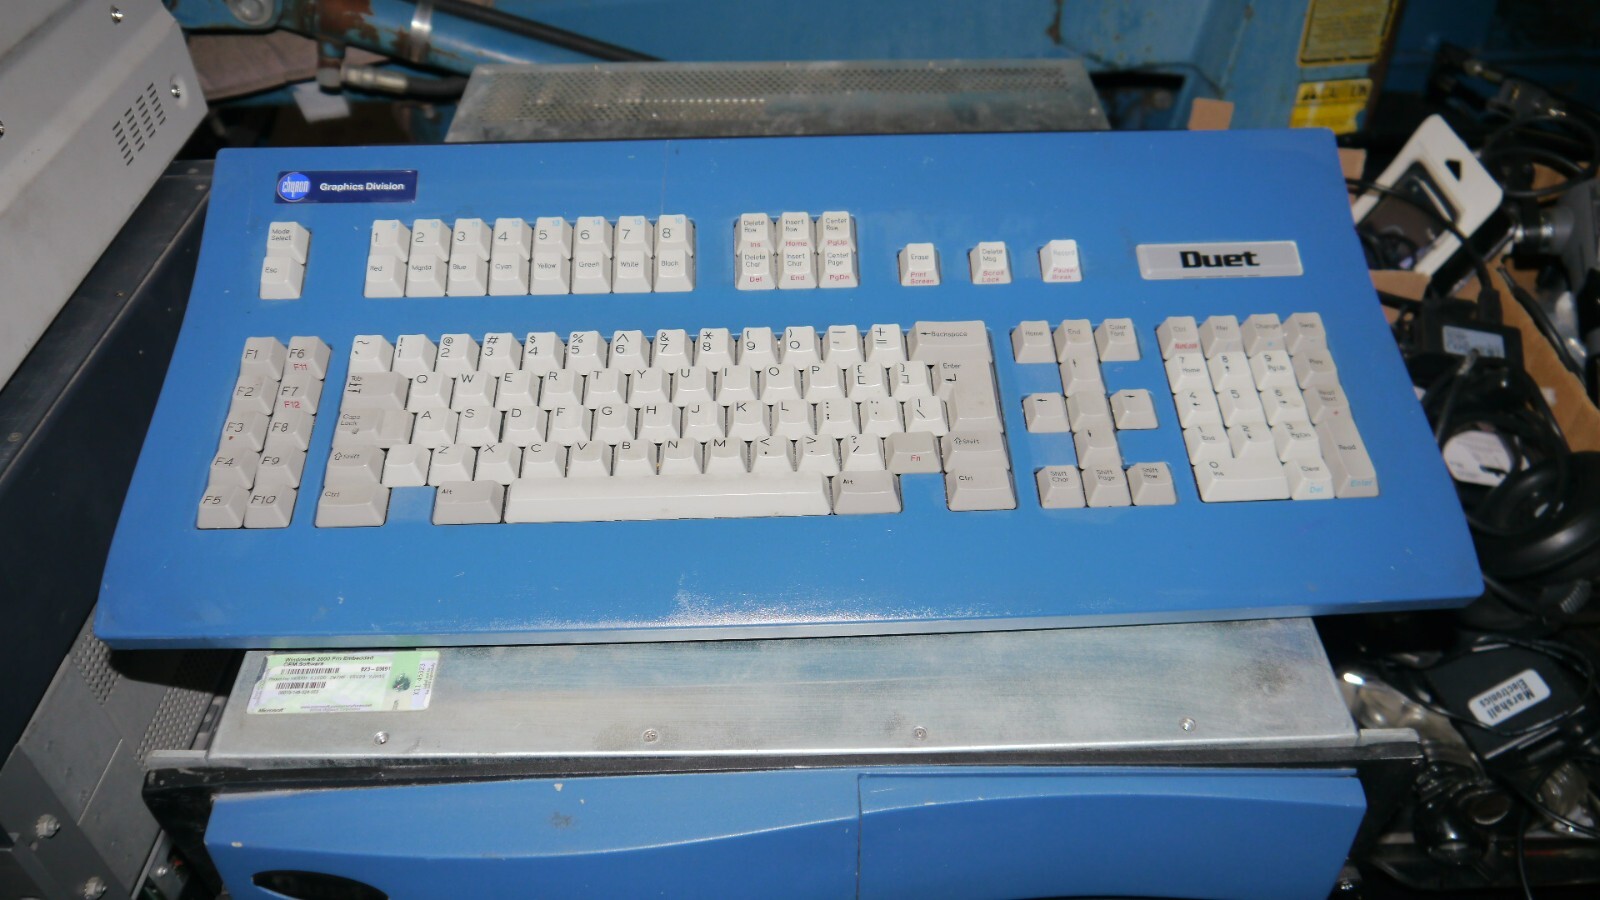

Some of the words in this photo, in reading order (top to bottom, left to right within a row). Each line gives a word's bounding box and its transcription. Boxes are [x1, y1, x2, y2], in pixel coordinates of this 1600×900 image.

[319, 182, 364, 192] Graphics
[365, 181, 405, 191] Division
[415, 232, 425, 243] 2
[456, 231, 466, 242] 3
[498, 231, 508, 242] 4
[538, 229, 548, 241] 5
[580, 229, 590, 240] 6
[622, 228, 631, 240] 7
[662, 227, 671, 239] 8
[910, 253, 929, 261] Erase
[983, 255, 997, 263] Msg
[1179, 250, 1260, 269] Duet
[265, 266, 278, 274] Esc
[452, 263, 467, 271] Blue
[495, 263, 512, 271] Cyan
[829, 274, 850, 282] PgDn
[528, 346, 538, 356] 4
[571, 345, 580, 355] 5
[615, 344, 625, 354] 6
[660, 343, 670, 353] 7
[702, 341, 712, 351] 8
[746, 341, 756, 351] 9
[245, 348, 258, 359] F1
[289, 348, 305, 359] F6
[440, 348, 450, 358] 2
[485, 347, 494, 357] 3
[1264, 354, 1272, 362] 9
[293, 363, 308, 371] F11
[811, 365, 820, 375] P
[942, 362, 962, 370] Enter
[504, 372, 513, 383] E
[548, 371, 558, 381] R
[593, 370, 603, 380] T
[637, 369, 647, 379] Y
[680, 368, 691, 378] U
[416, 374, 428, 384] Q
[461, 374, 474, 383] W
[236, 386, 254, 397] F2
[281, 386, 299, 397] F7
[1230, 389, 1240, 399] 5
[284, 400, 300, 409] F12
[691, 404, 700, 414] J
[736, 402, 747, 412] K
[781, 401, 789, 412] L
[420, 410, 432, 420] A
[464, 408, 475, 419] S
[511, 408, 522, 418] D
[556, 407, 566, 417] F
[602, 406, 613, 416] G
[646, 405, 657, 415] H
[226, 422, 244, 433] F3
[272, 422, 289, 433] F8
[531, 443, 541, 453] C
[577, 442, 588, 451] V
[622, 441, 632, 450] B
[667, 440, 679, 449] N
[713, 438, 726, 448] M
[438, 445, 450, 455] Z
[484, 444, 496, 453] X
[214, 457, 234, 467] F4
[261, 456, 280, 466] F9
[911, 454, 921, 462] Fn
[1350, 479, 1373, 487] Enter
[203, 495, 221, 505] F5
[251, 495, 277, 505] F10
[1479, 679, 1529, 707] Electronics
[1486, 689, 1536, 719] Marshall
